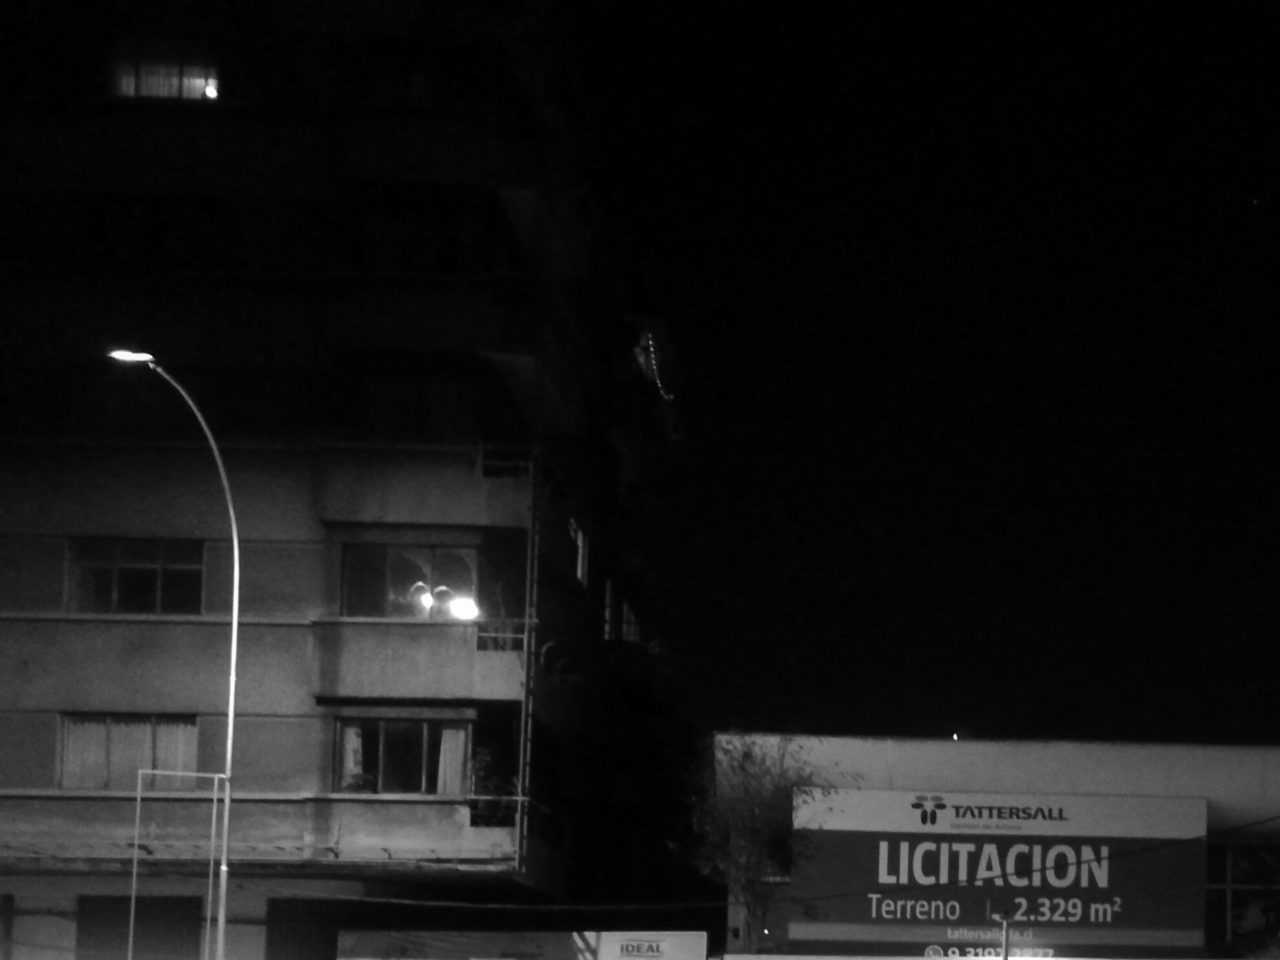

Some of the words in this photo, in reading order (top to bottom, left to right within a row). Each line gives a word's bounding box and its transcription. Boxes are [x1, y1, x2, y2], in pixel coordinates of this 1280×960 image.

[951, 805, 1069, 821] TATTERSALL
[878, 841, 1109, 889] LICITACION
[868, 894, 960, 920] Terreno
[1014, 897, 1083, 922] 2.329
[620, 943, 665, 954] IDEAL
